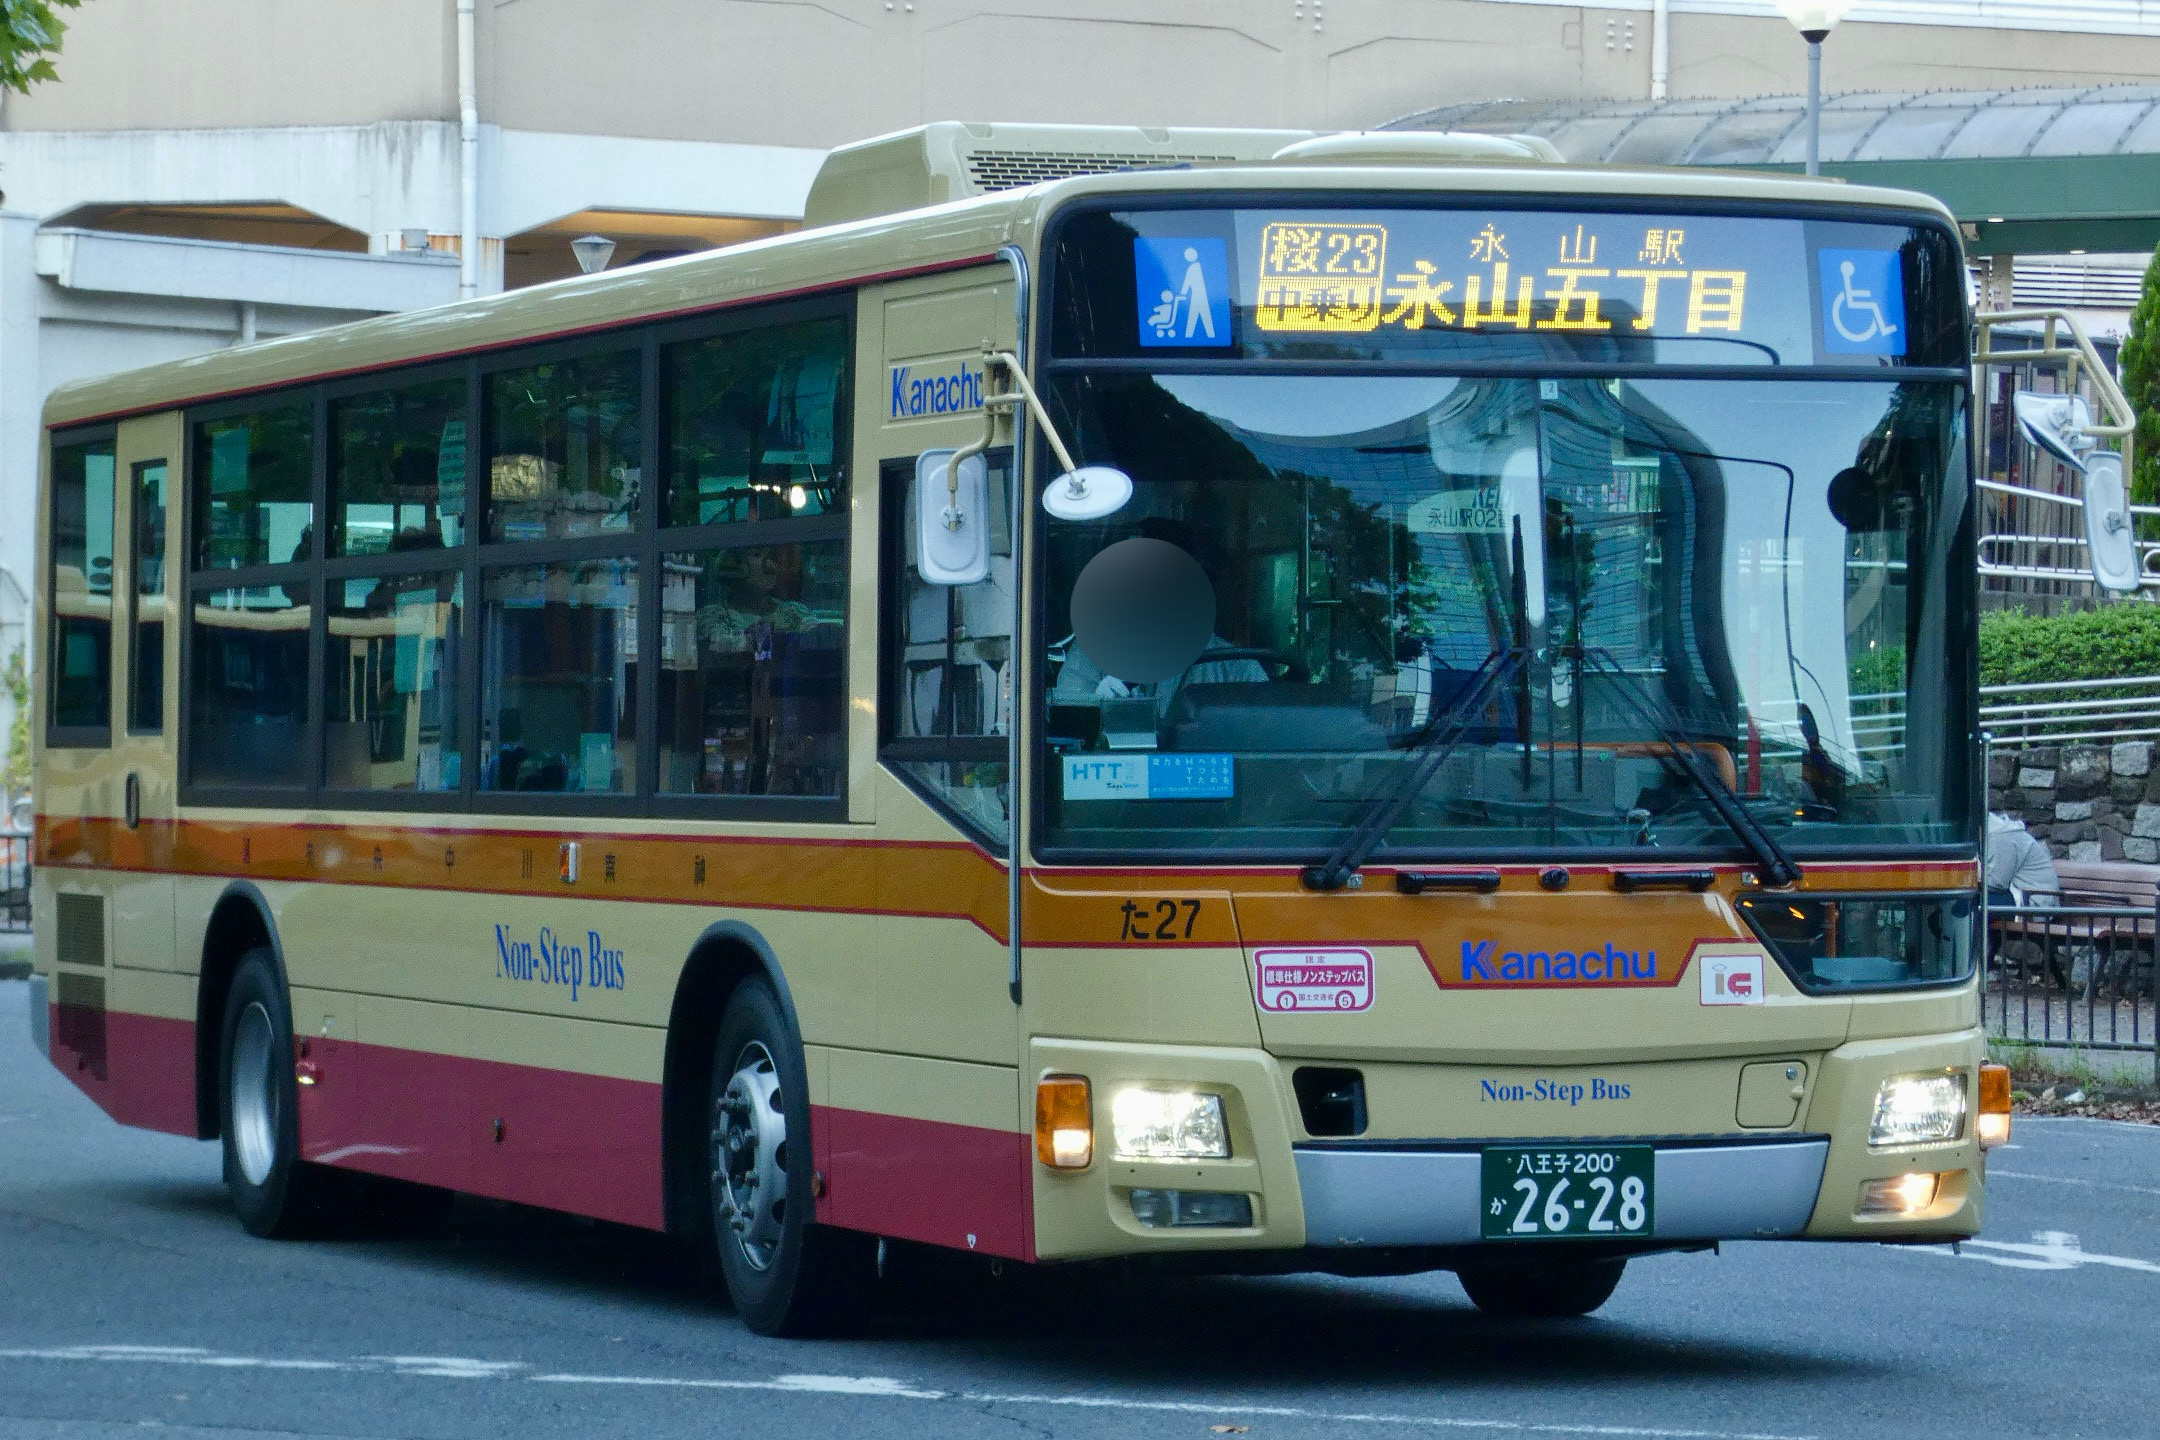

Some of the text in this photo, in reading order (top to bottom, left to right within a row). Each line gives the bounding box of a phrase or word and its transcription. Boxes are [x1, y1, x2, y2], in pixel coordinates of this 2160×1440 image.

[1270, 226, 1379, 273] 桜23
[1470, 223, 1685, 265] 永山駅
[1381, 259, 1747, 333] 永山五丁目
[1072, 763, 1123, 780] HTT
[1120, 899, 1201, 941] た27
[495, 923, 625, 1002] Non-Step Bus
[1461, 940, 1657, 981] Kanachu
[1480, 1078, 1632, 1107] Non-Step Bus
[1490, 1176, 1646, 1233] か 26-28
